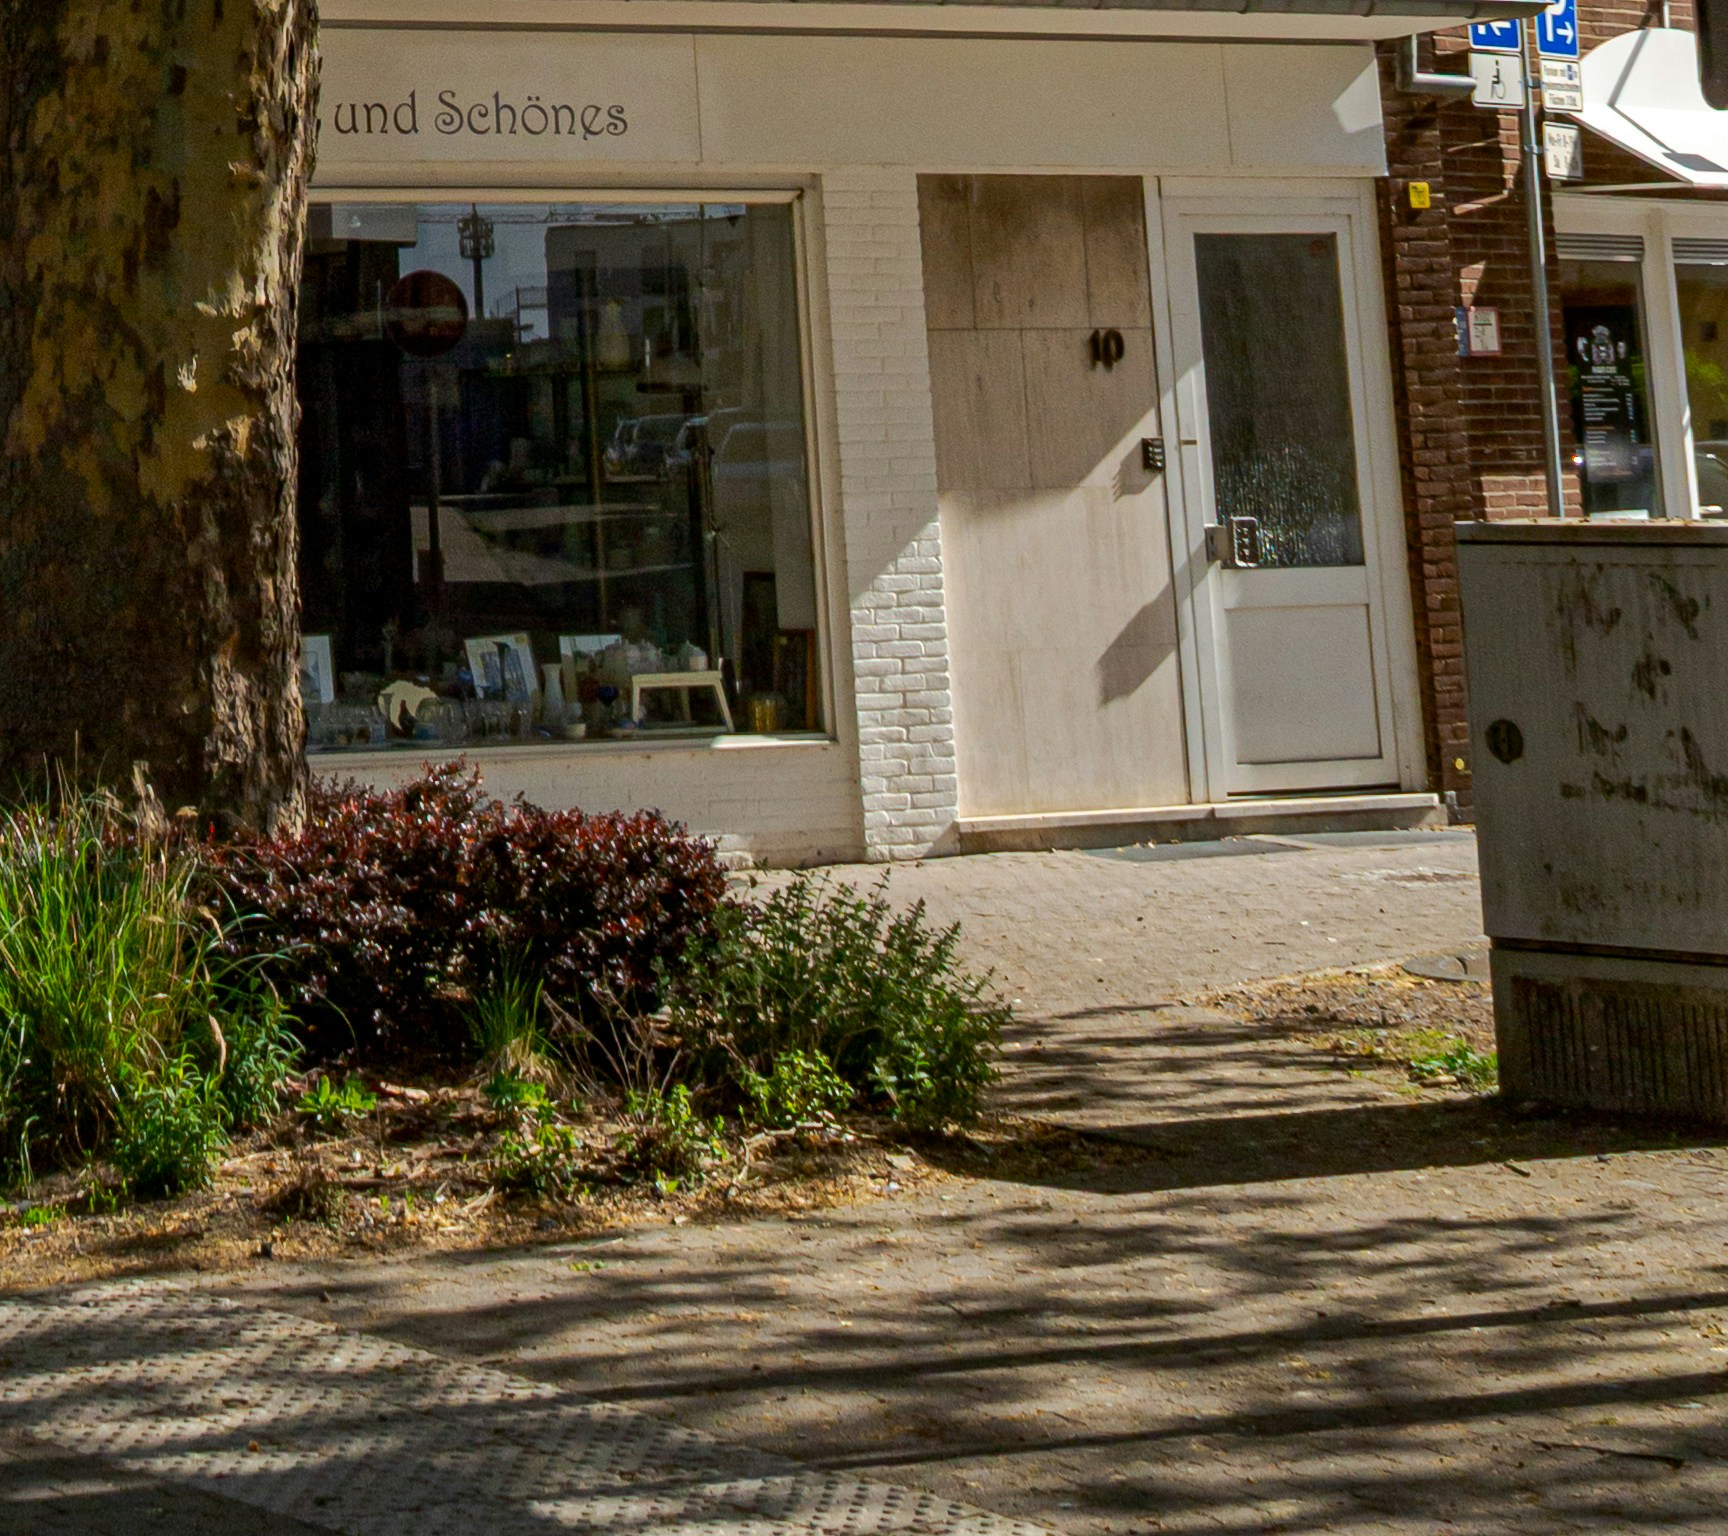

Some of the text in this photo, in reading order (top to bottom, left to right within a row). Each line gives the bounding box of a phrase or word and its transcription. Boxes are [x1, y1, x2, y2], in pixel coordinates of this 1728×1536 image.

[334, 89, 628, 140] und Schönes
[1089, 329, 1124, 363] 10
